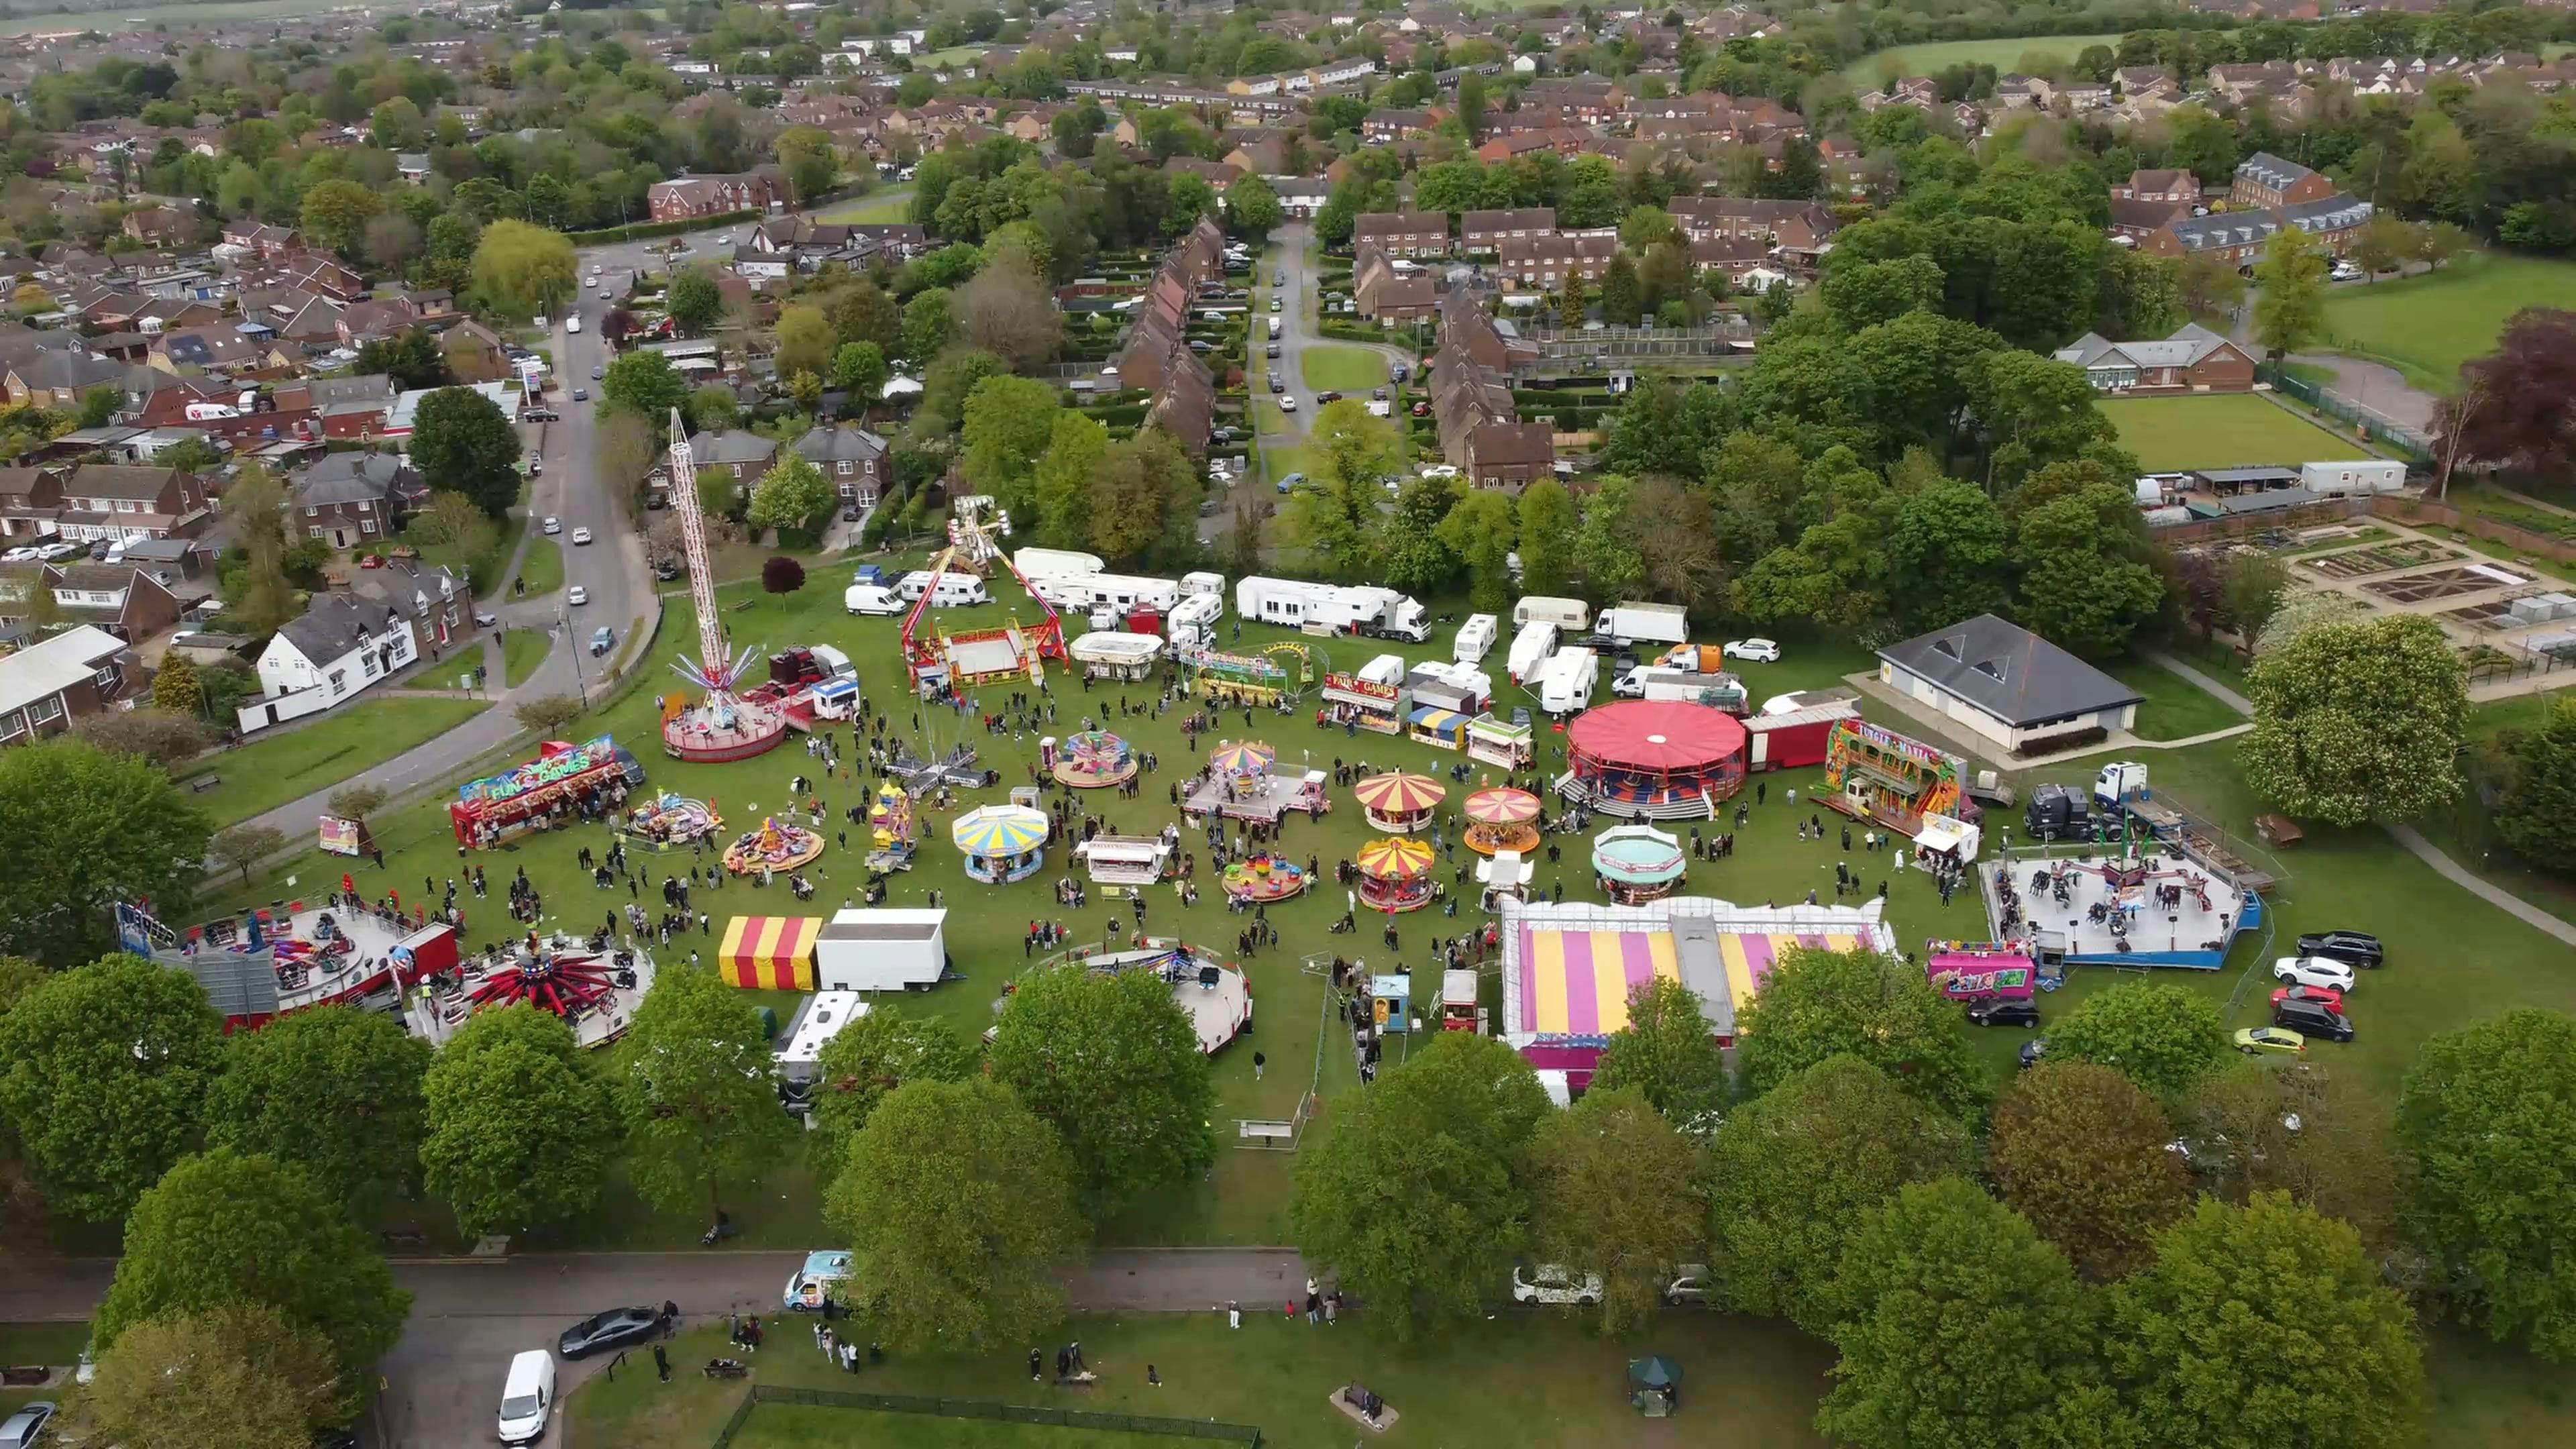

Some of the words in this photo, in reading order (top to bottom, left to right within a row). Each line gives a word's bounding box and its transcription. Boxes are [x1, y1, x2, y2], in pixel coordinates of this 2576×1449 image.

[1332, 675, 1353, 689] FAIR
[1364, 682, 1394, 696] GAMES
[1858, 723, 1890, 746] JUNGLE
[492, 781, 522, 800] FUN
[539, 756, 590, 782] GAMES
